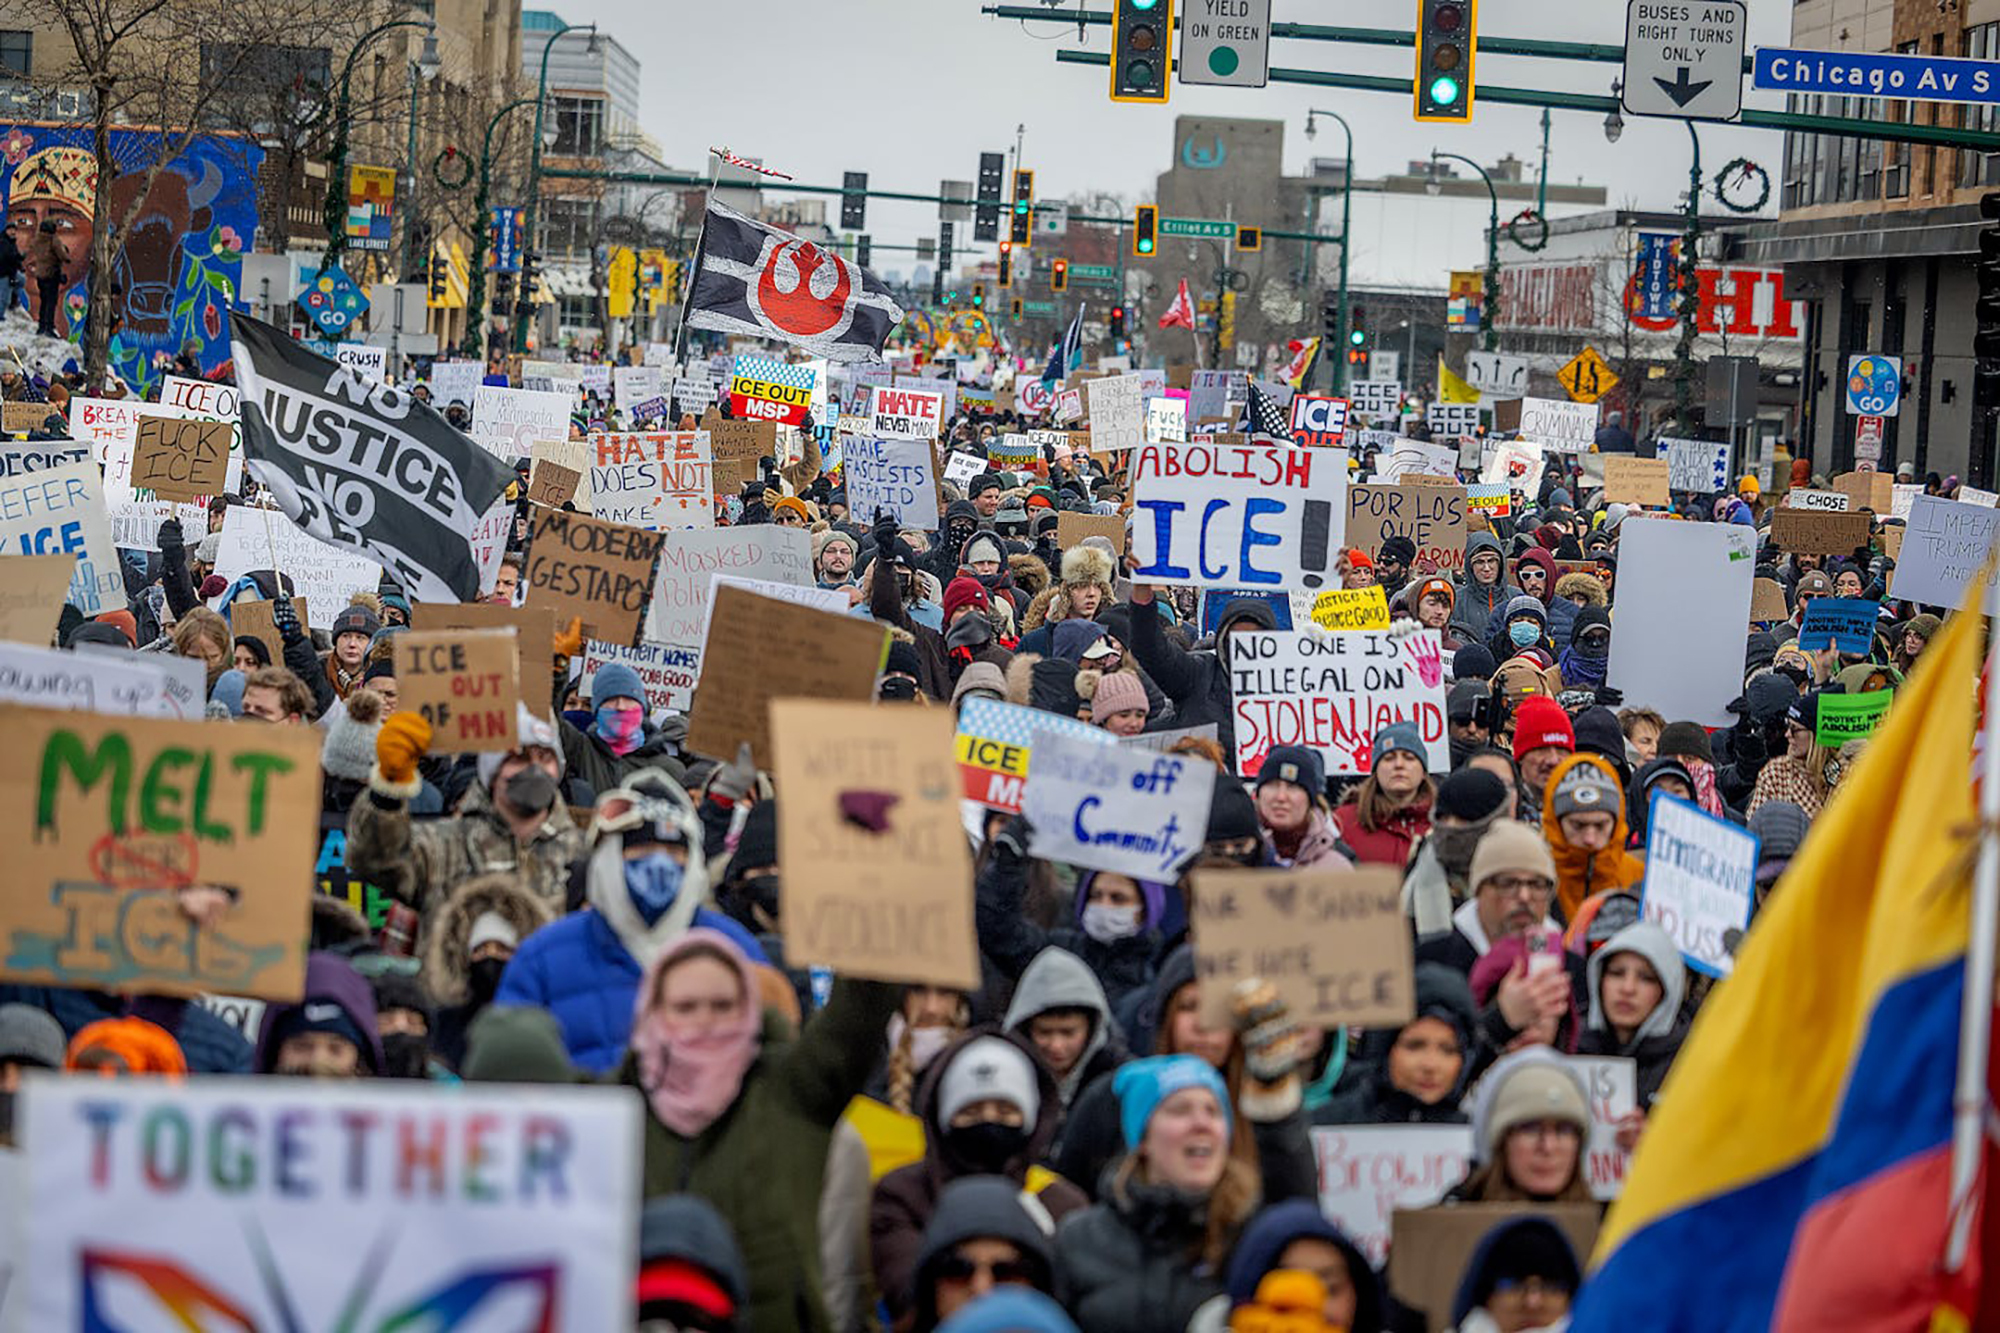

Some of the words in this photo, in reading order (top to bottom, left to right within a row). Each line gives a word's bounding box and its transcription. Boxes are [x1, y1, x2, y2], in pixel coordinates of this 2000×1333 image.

[1204, 0, 1249, 17] YIELD
[1638, 5, 1689, 22] BUSES
[1702, 8, 1735, 24] AND
[1192, 24, 1210, 38] ON
[1217, 25, 1259, 40] GREEN
[1637, 25, 1678, 41] RIGHT
[1690, 28, 1734, 44] TURNS
[1662, 46, 1707, 62] ONLY
[1771, 58, 1905, 94] Chicago
[1917, 67, 1959, 92] Av
[1972, 70, 1990, 94] S
[349, 238, 365, 248] LAKE
[365, 239, 389, 250] STREET
[1652, 237, 1664, 315] MIDTOWN
[320, 311, 346, 325] GO
[338, 351, 381, 368] CRUSH
[169, 381, 213, 412] ICE
[217, 390, 241, 416] OU
[324, 363, 411, 419] NO
[733, 378, 765, 396] ICE
[769, 385, 810, 404] OUT
[1353, 384, 1397, 397] ICE
[83, 405, 142, 425] BREAK
[746, 398, 790, 420] MSP
[878, 390, 938, 418] HATE
[1295, 398, 1346, 433] ICE
[1353, 400, 1396, 412] OUT
[1431, 407, 1476, 419] ICE
[1860, 397, 1884, 411] GO
[875, 415, 910, 433] NEVER
[1149, 411, 1184, 427] FUCK
[1431, 423, 1475, 434] OUT
[1523, 410, 1594, 441] CRIMINALS
[92, 427, 127, 439] THE
[138, 420, 220, 457] FUCK
[1029, 432, 1045, 443] ICE
[1047, 433, 1068, 445] OUT
[596, 434, 699, 466] HATE
[845, 440, 888, 463] MAKE
[1010, 455, 1033, 463] OUT
[143, 453, 212, 484] ICE
[846, 458, 925, 485] FASCISTS
[966, 461, 980, 469] OUT
[1136, 446, 1312, 488] ABOLISH
[591, 464, 656, 494] DOES
[662, 463, 710, 490] NOT
[0, 479, 90, 521] EFER
[304, 465, 375, 528] NO
[542, 481, 565, 505] ICE
[849, 482, 914, 505] AFRAID
[1467, 498, 1480, 506] CE
[1482, 496, 1505, 505] OUT
[1806, 494, 1847, 510] CHOSE
[595, 506, 654, 522] MAKE
[1352, 488, 1403, 519] POR
[1416, 494, 1462, 525] LOS
[20, 521, 88, 560] ICE
[253, 537, 290, 551] CARY
[534, 513, 666, 563] MODERN
[1133, 498, 1331, 588] ICE!
[1921, 535, 1983, 559] TRUMP
[531, 555, 653, 611] GESTAPO
[1364, 589, 1376, 602] 4
[407, 643, 466, 676] ICE
[1234, 636, 1277, 661] NO
[1298, 637, 1346, 656] ONE
[1364, 635, 1398, 658] IS
[453, 674, 503, 697] OUT
[1233, 667, 1355, 696] ILLEGAL
[1364, 666, 1404, 691] ON
[458, 711, 506, 740] MN
[1237, 697, 1356, 754] STOLEN
[1822, 714, 1862, 723] PROTECT
[1822, 723, 1870, 732] ABOLISH
[967, 738, 1021, 771] ICE
[36, 728, 295, 842] MELT
[1131, 758, 1183, 794] off
[1314, 970, 1393, 1013] ICE
[77, 1102, 574, 1205] TOGETHER
